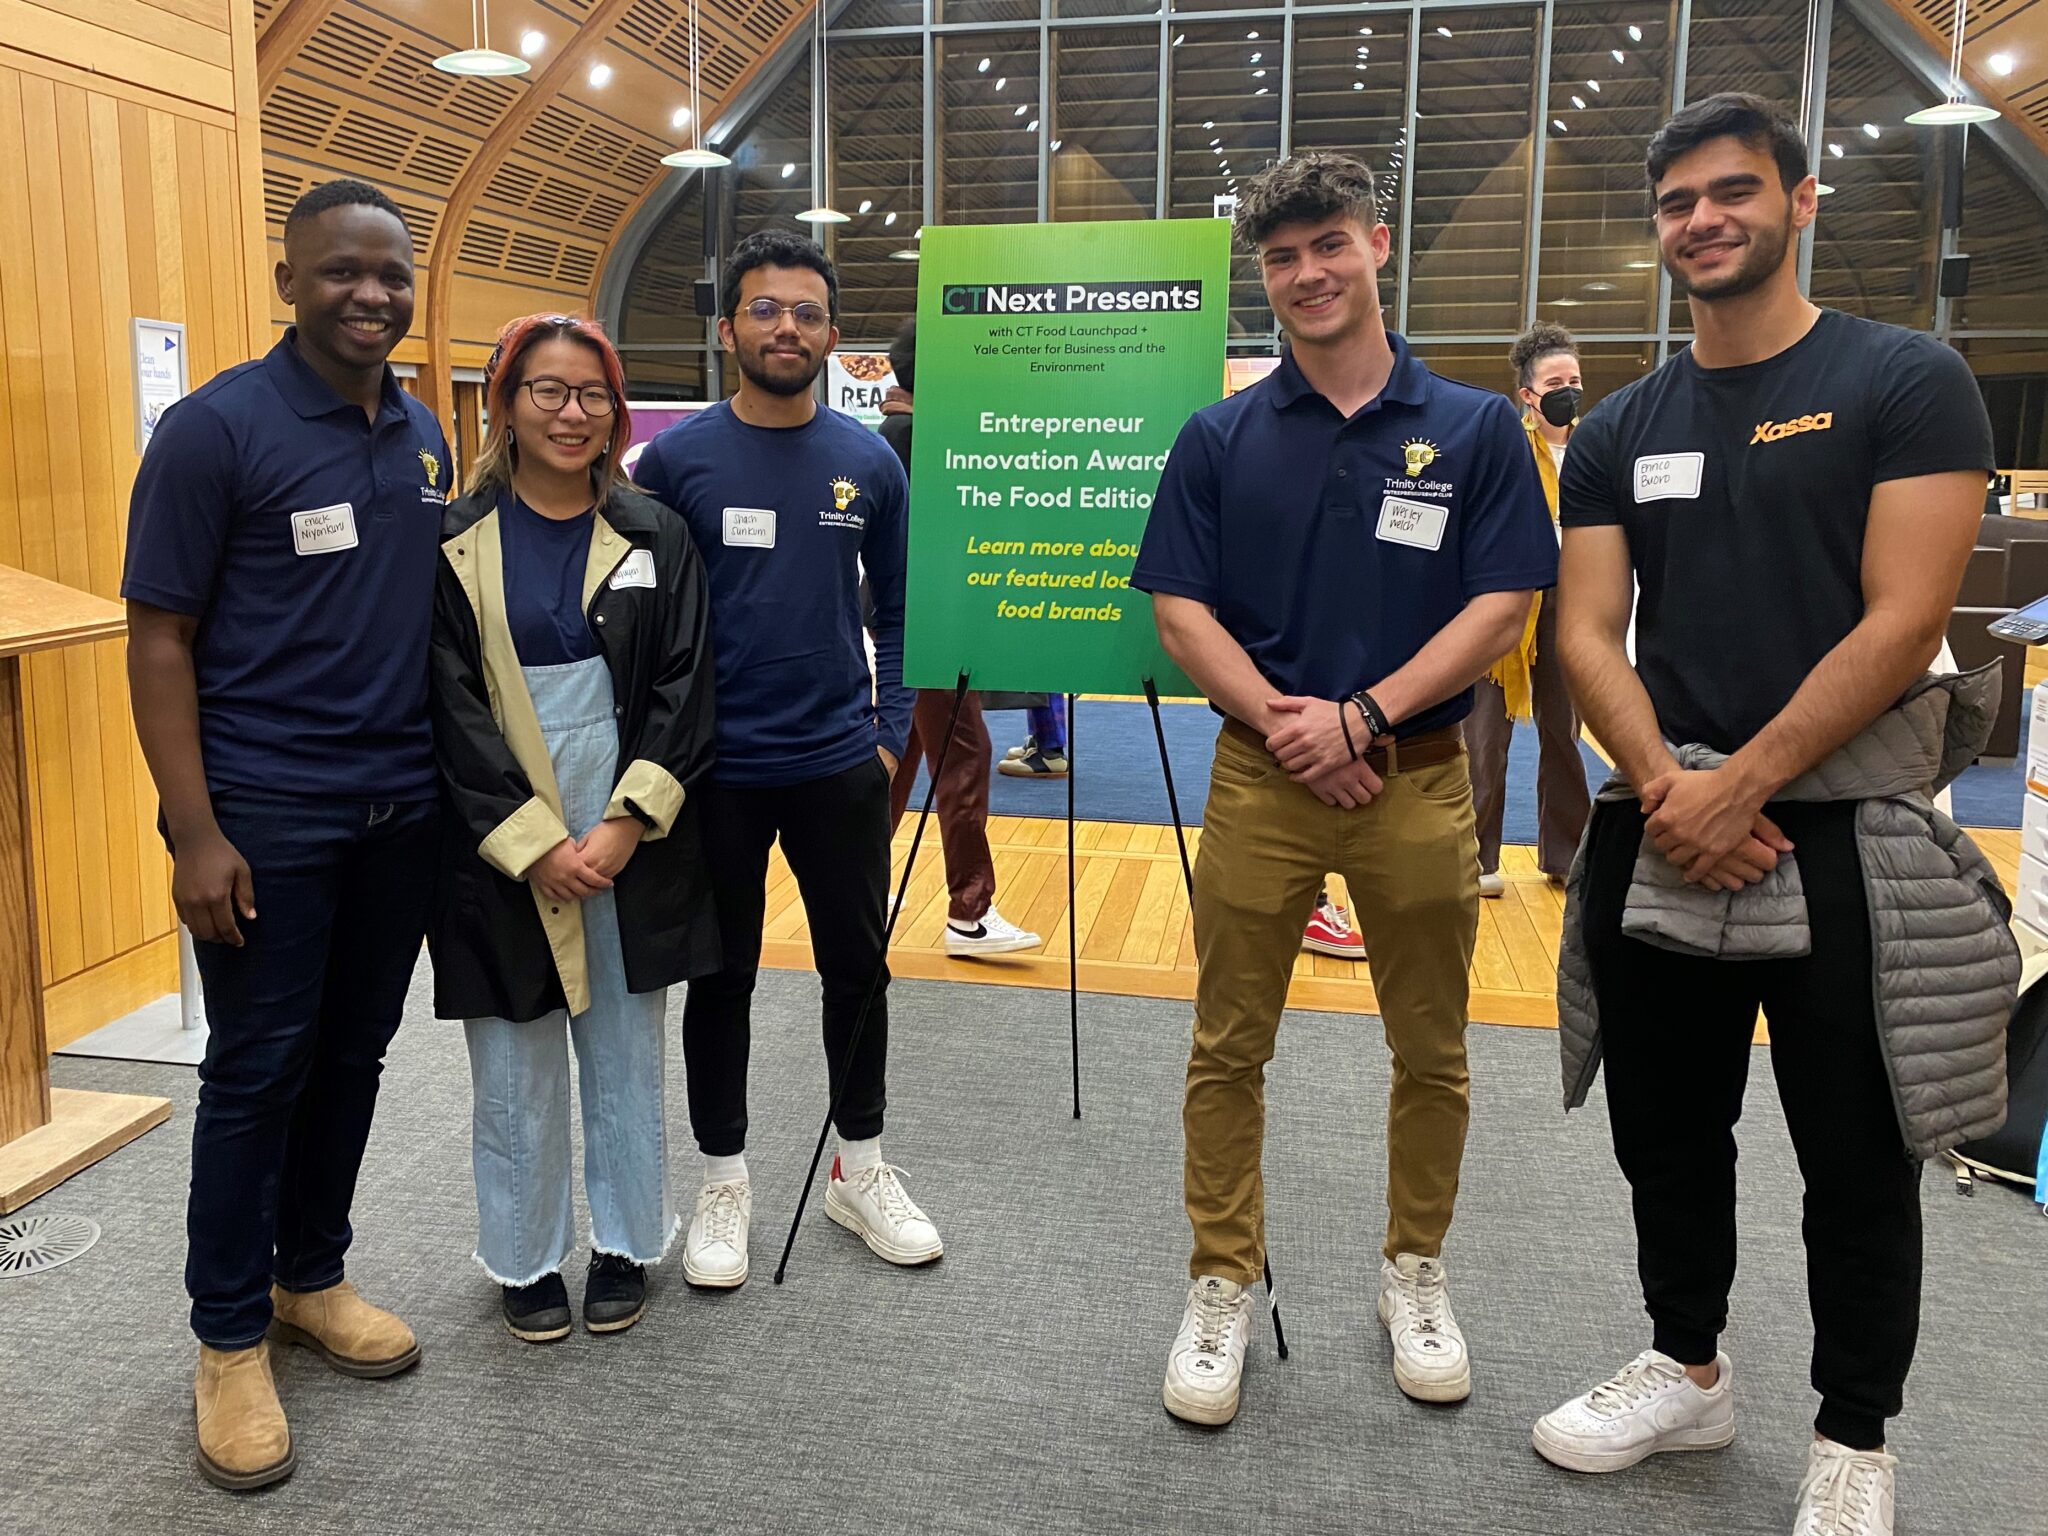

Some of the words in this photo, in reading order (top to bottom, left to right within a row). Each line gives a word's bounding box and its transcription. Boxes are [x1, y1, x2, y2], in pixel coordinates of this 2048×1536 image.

[1067, 285, 1199, 311] Presents
[989, 326, 1012, 336] with
[1016, 327, 1032, 337] CT
[1036, 326, 1066, 336] Food
[1070, 325, 1137, 338] Launchpad
[974, 344, 999, 355] Yale
[1002, 344, 1040, 354] Center
[1045, 344, 1060, 354] for
[1064, 343, 1115, 354] Business
[1119, 343, 1142, 353] and
[1146, 343, 1165, 353] the
[1030, 361, 1104, 372] Environment
[842, 386, 883, 408] REA
[980, 412, 1144, 439] Entrepreneur
[945, 449, 1078, 470] Innovation
[1086, 449, 1170, 471] Award
[1385, 478, 1417, 490] Trinity
[1418, 480, 1453, 492] College
[956, 486, 1002, 507] The
[1010, 487, 1071, 507] Food
[1080, 488, 1156, 509] Editio
[819, 511, 845, 521] Trinity
[966, 536, 1024, 556] Learn
[1030, 541, 1084, 557] more
[1089, 538, 1139, 558] abou
[966, 571, 1001, 586] our
[1005, 568, 1096, 588] featured
[1100, 570, 1131, 589] loc
[996, 600, 1044, 619] food
[1048, 602, 1122, 621] brands
